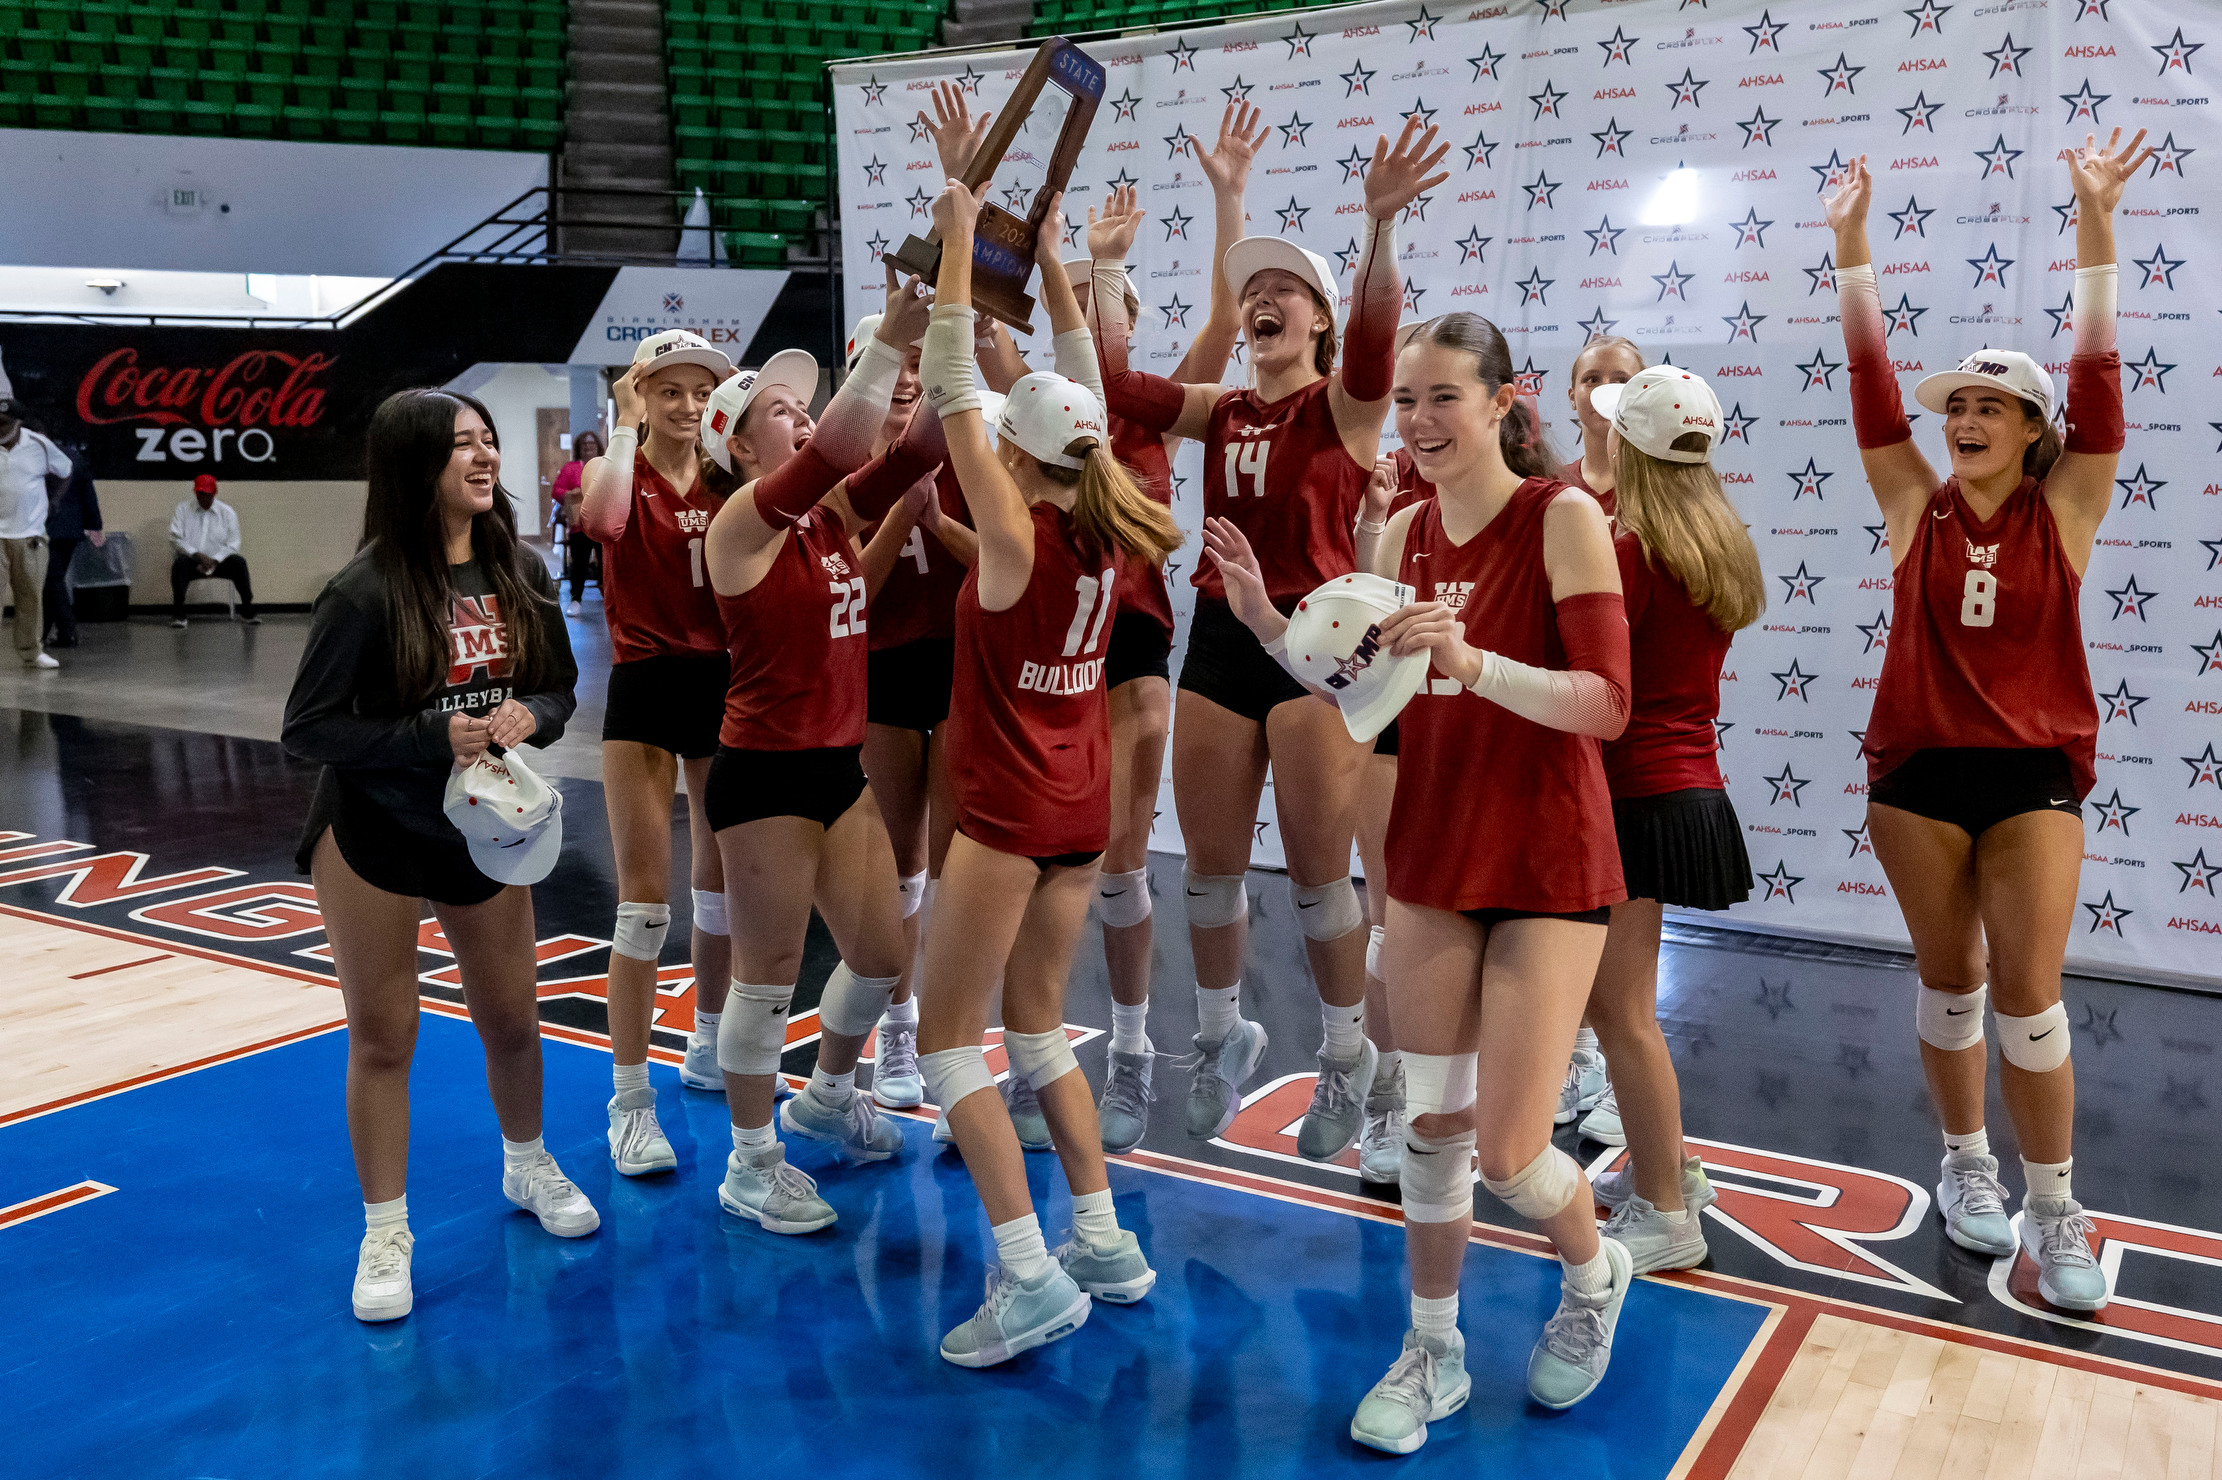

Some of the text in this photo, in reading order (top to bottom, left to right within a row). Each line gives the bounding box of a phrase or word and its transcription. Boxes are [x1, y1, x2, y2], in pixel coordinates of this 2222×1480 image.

[1469, 6, 1508, 21] AHSAA
[1809, 18, 1878, 31] @AHSAA_SPORTS
[1343, 26, 1380, 38] AHSAA
[1223, 41, 1258, 53] AHSAA
[1521, 47, 1579, 60] @AHSAA_SPORTS
[2064, 45, 2116, 59] AHSAA
[1111, 55, 1143, 67] AHSAA
[1898, 58, 1947, 73] AHSAA
[1005, 69, 1025, 80] AHS
[1059, 53, 1100, 92] STATE
[907, 81, 935, 91] AHSAA
[1738, 74, 1784, 88] AHSAA
[1593, 87, 1636, 100] AHSAA
[1464, 100, 1502, 115] AHSAA
[2132, 97, 2209, 107] @AHSAA_SPORTS
[1337, 116, 1374, 129] AHSAA
[1802, 114, 1870, 127] @AHSAA_SPORTS
[1107, 141, 1139, 152] AHSAA
[1515, 137, 1572, 149] @AHSAA_SPORTS
[906, 161, 933, 171] AHSAA
[1890, 157, 1939, 171] AHSAA
[1732, 168, 1777, 182] AHSAA
[1587, 179, 1629, 191] AHSAA
[173, 190, 195, 206] EXIT
[1458, 190, 1496, 203] AHSAA
[1335, 204, 1364, 215] AHSA
[2123, 207, 2199, 218] @AHSAA_SPORTS
[1508, 235, 1565, 245] @AHSAA_SPORTS
[1882, 261, 1930, 275] AHSAA
[2048, 259, 2077, 273] AHS
[1580, 277, 1622, 289] AHSAA
[1724, 271, 1770, 283] AHSAA
[1451, 284, 1489, 297] AHSAA
[1501, 325, 1559, 333] @AHSAA_SPORTS
[1717, 366, 1762, 377] AHSAA
[2044, 362, 2069, 374] AHS
[76, 348, 340, 427] Coca-Cola
[1682, 415, 1715, 428] AHSAA
[1779, 419, 1847, 428] @AHSAA_SPORTS
[2126, 421, 2181, 432] SAA_SPORTS
[135, 428, 273, 462] zero
[1224, 440, 1271, 498] 14
[1719, 473, 1755, 485] HSAA
[1771, 527, 1838, 537] @AHSAA_SPORTS
[2096, 538, 2172, 549] @AHSAA_SPORTS
[1961, 569, 1997, 628] 8
[2194, 595, 2222, 608] AHS
[829, 576, 867, 639] 22
[1061, 567, 1116, 657] 11
[1763, 624, 1830, 635] @AHSAA_SPORTS
[2089, 641, 2162, 654] @AHSAA_SPORTS
[1851, 677, 1880, 689] AHS
[1755, 728, 1823, 739] @AHSAA_SPORTS
[2095, 753, 2152, 765] HSAA_SPORTS
[2175, 813, 2222, 828] AHSA
[1748, 824, 1816, 838] @AHSAA_SPORTS
[2083, 853, 2145, 867] AHSAA_SPORTS
[1837, 882, 1886, 897] AHSAA
[2167, 916, 2222, 934] AHSAA
